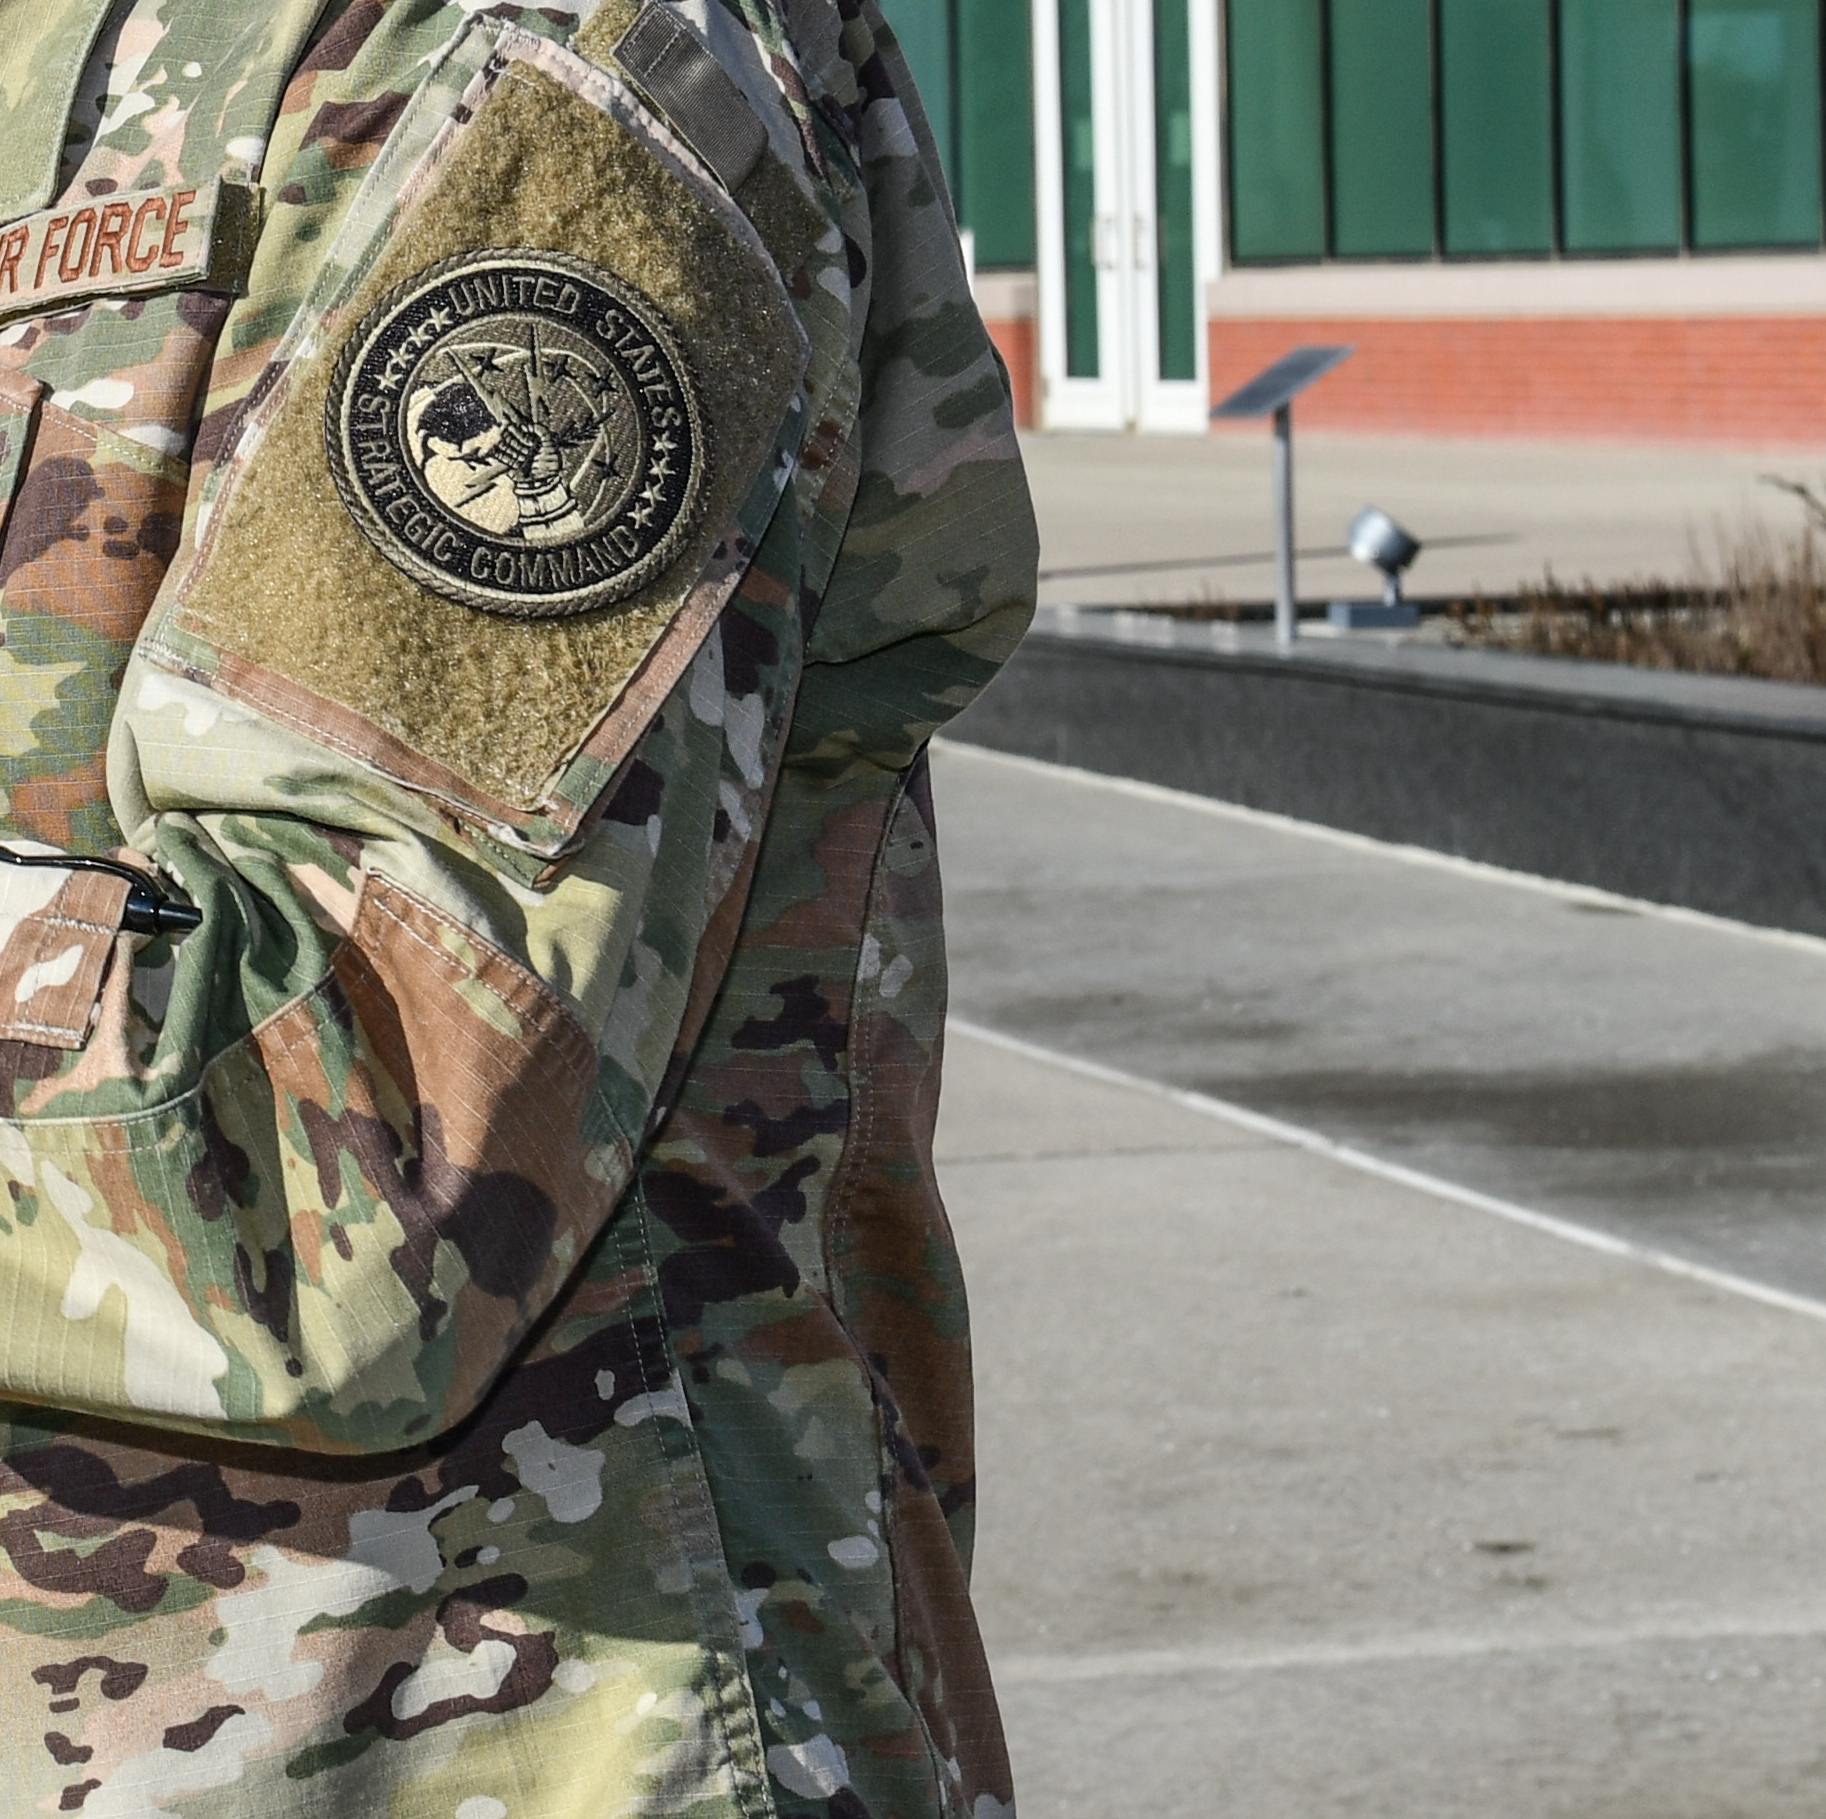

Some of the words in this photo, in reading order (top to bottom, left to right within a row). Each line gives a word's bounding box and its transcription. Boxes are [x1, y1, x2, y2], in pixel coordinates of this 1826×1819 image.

[33, 189, 196, 289] FORCE
[448, 276, 582, 317] UNITED
[595, 309, 684, 429] STATES
[359, 393, 460, 564] STRATEGIC
[470, 524, 641, 589] COMMAND
